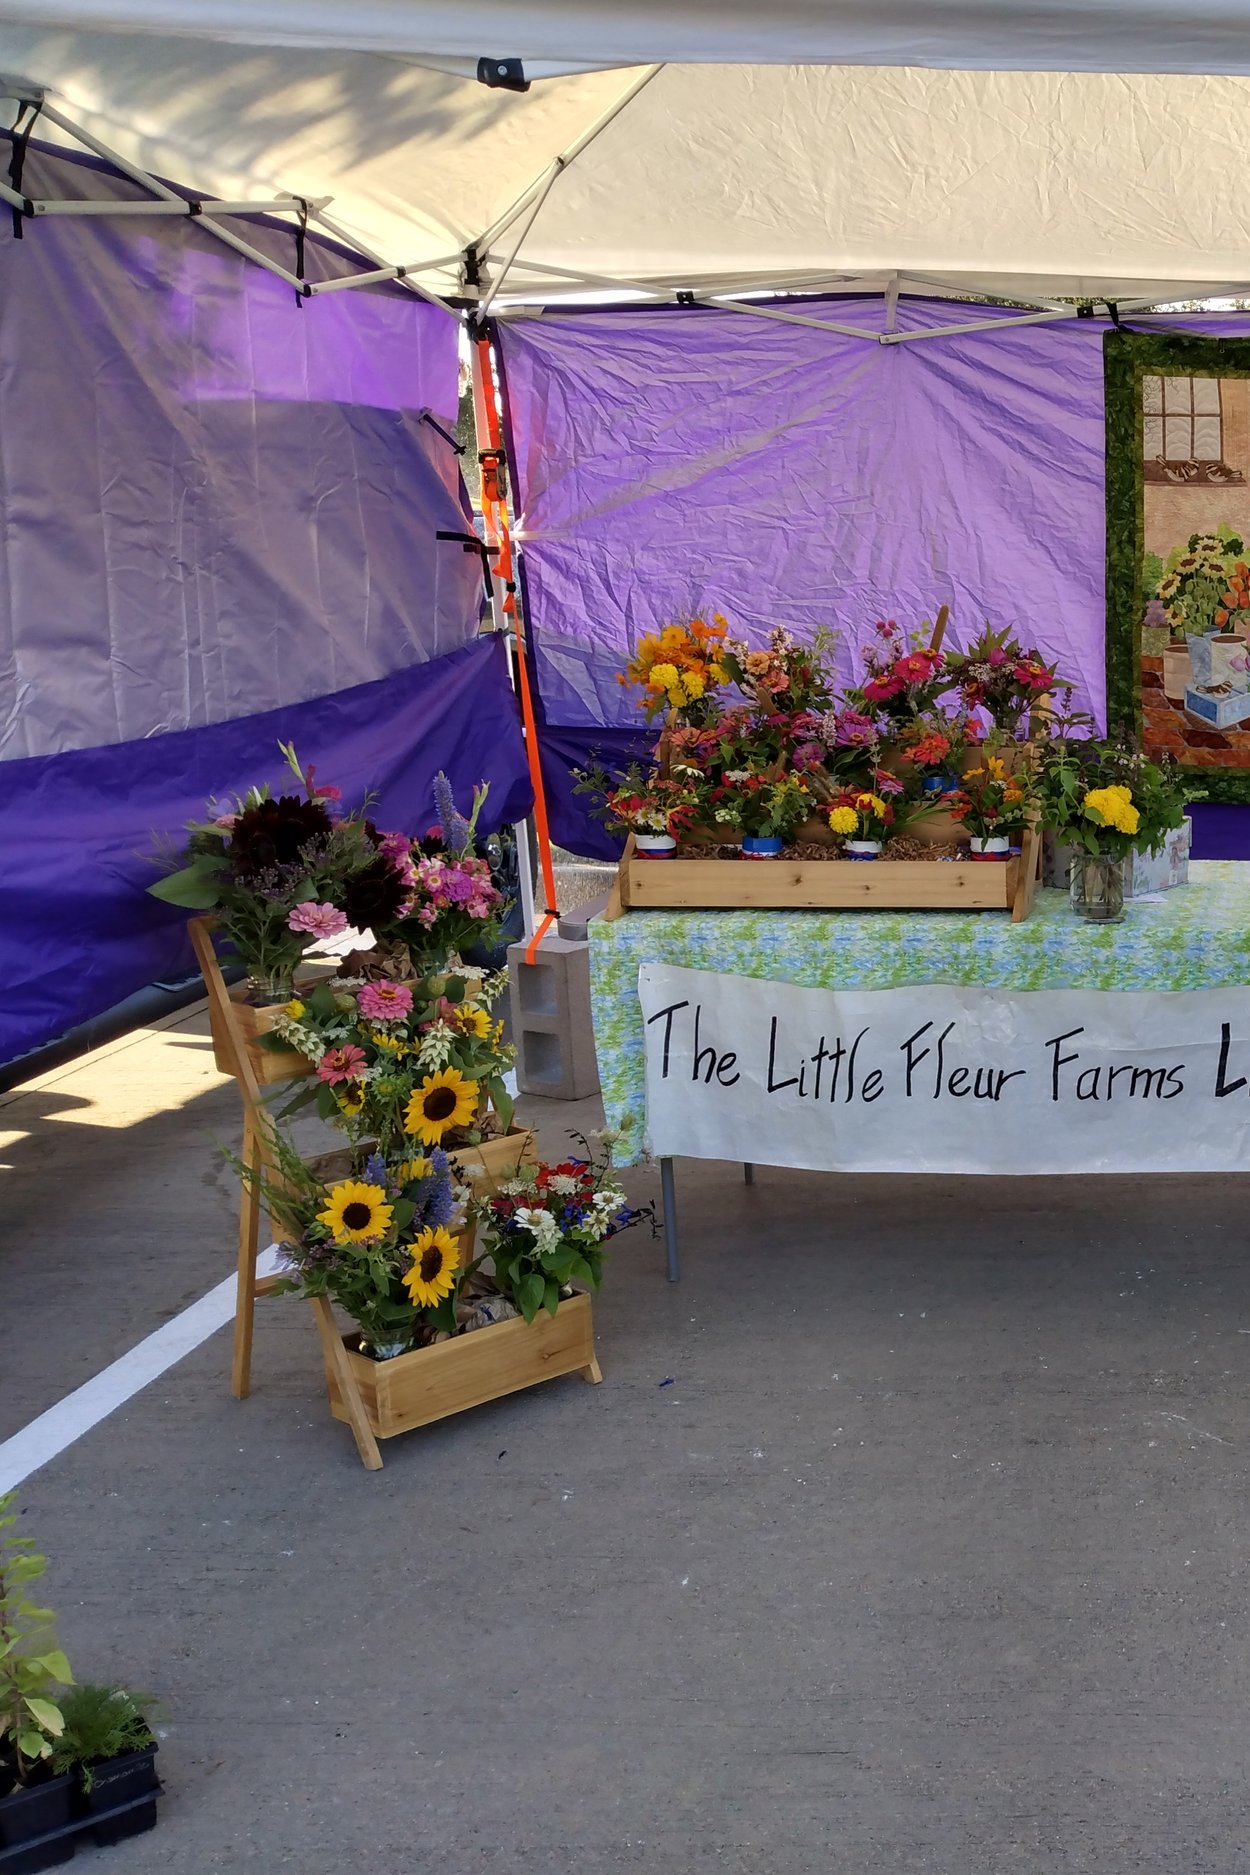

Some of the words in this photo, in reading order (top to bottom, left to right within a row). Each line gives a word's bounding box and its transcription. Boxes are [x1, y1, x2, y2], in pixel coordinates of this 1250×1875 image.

[647, 1001, 741, 1088] The
[766, 1016, 884, 1104] Little
[900, 1020, 1027, 1102] Fleur
[1045, 1027, 1185, 1102] Farms
